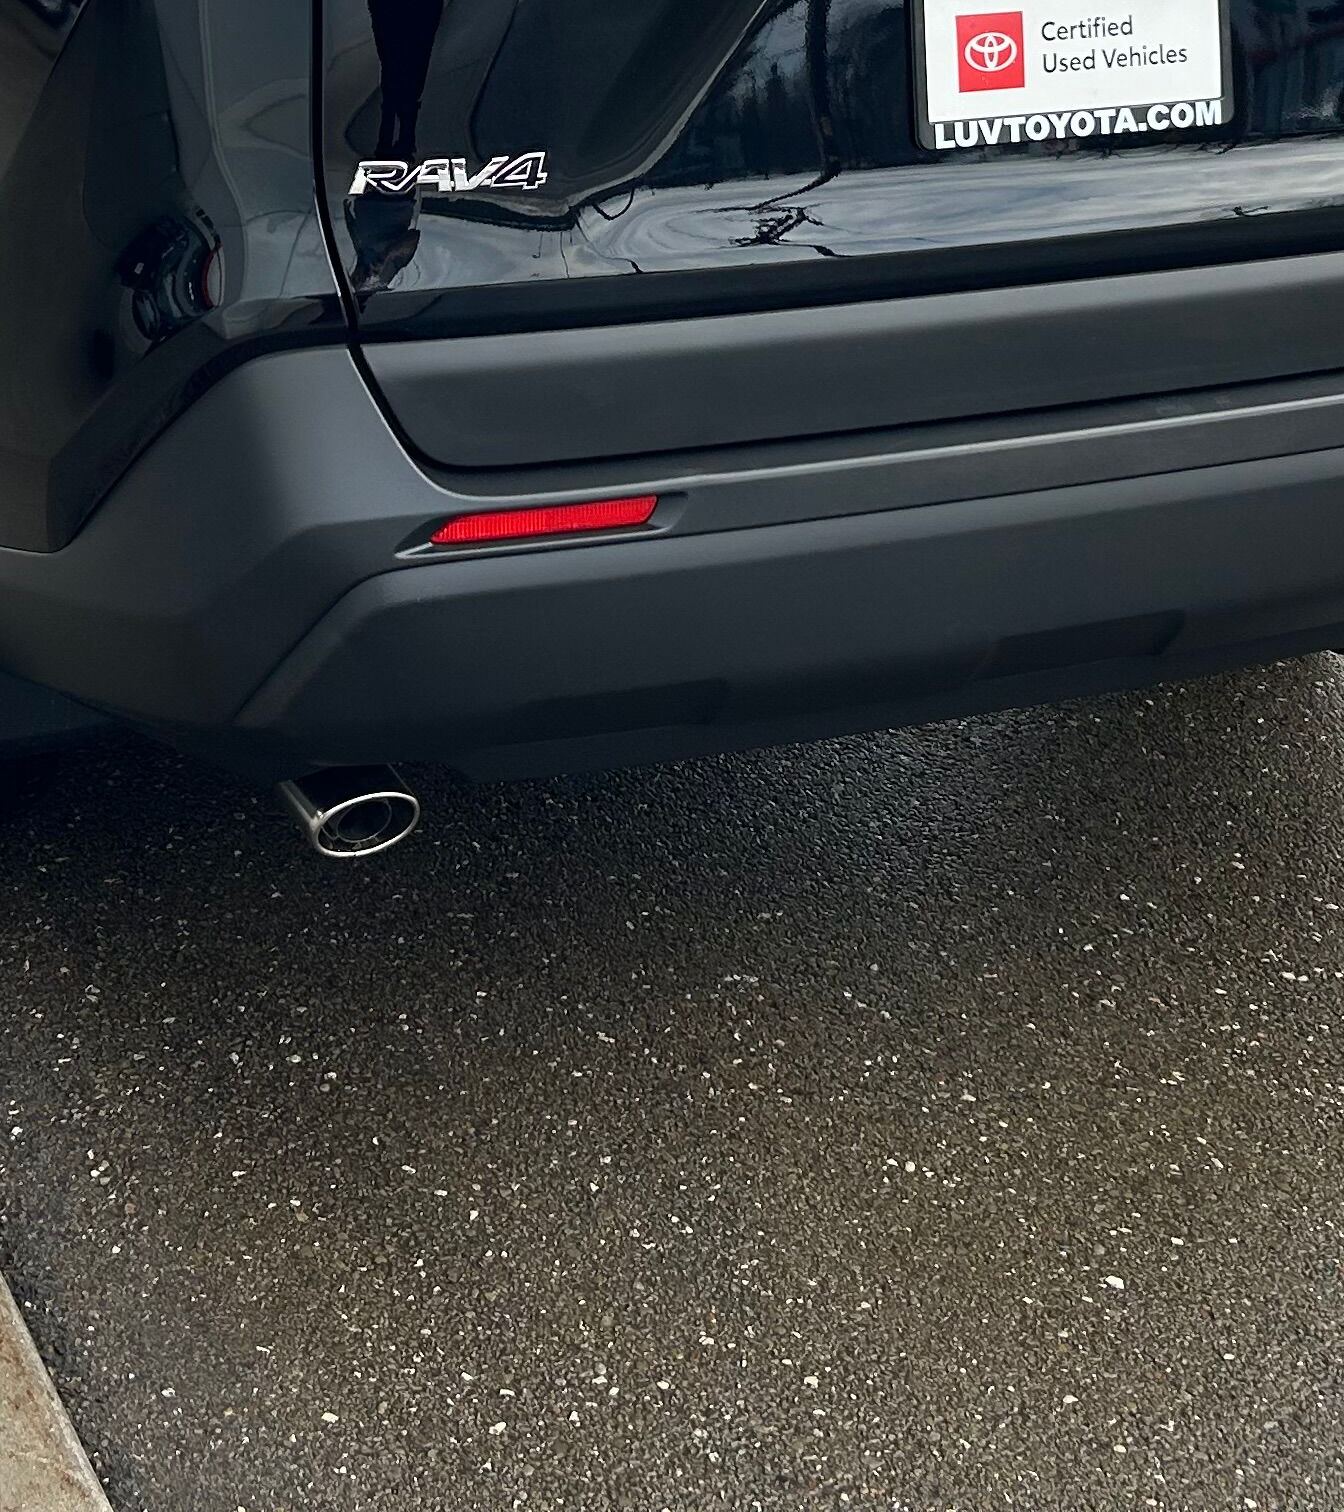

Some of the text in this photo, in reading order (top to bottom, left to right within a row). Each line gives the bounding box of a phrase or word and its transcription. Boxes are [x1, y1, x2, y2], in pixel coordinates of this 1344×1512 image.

[1041, 15, 1133, 41] Certified
[1042, 44, 1188, 73] Used Vehicles
[934, 100, 1222, 150] LUVTOYOTA.COM
[347, 151, 548, 196] RAV4
